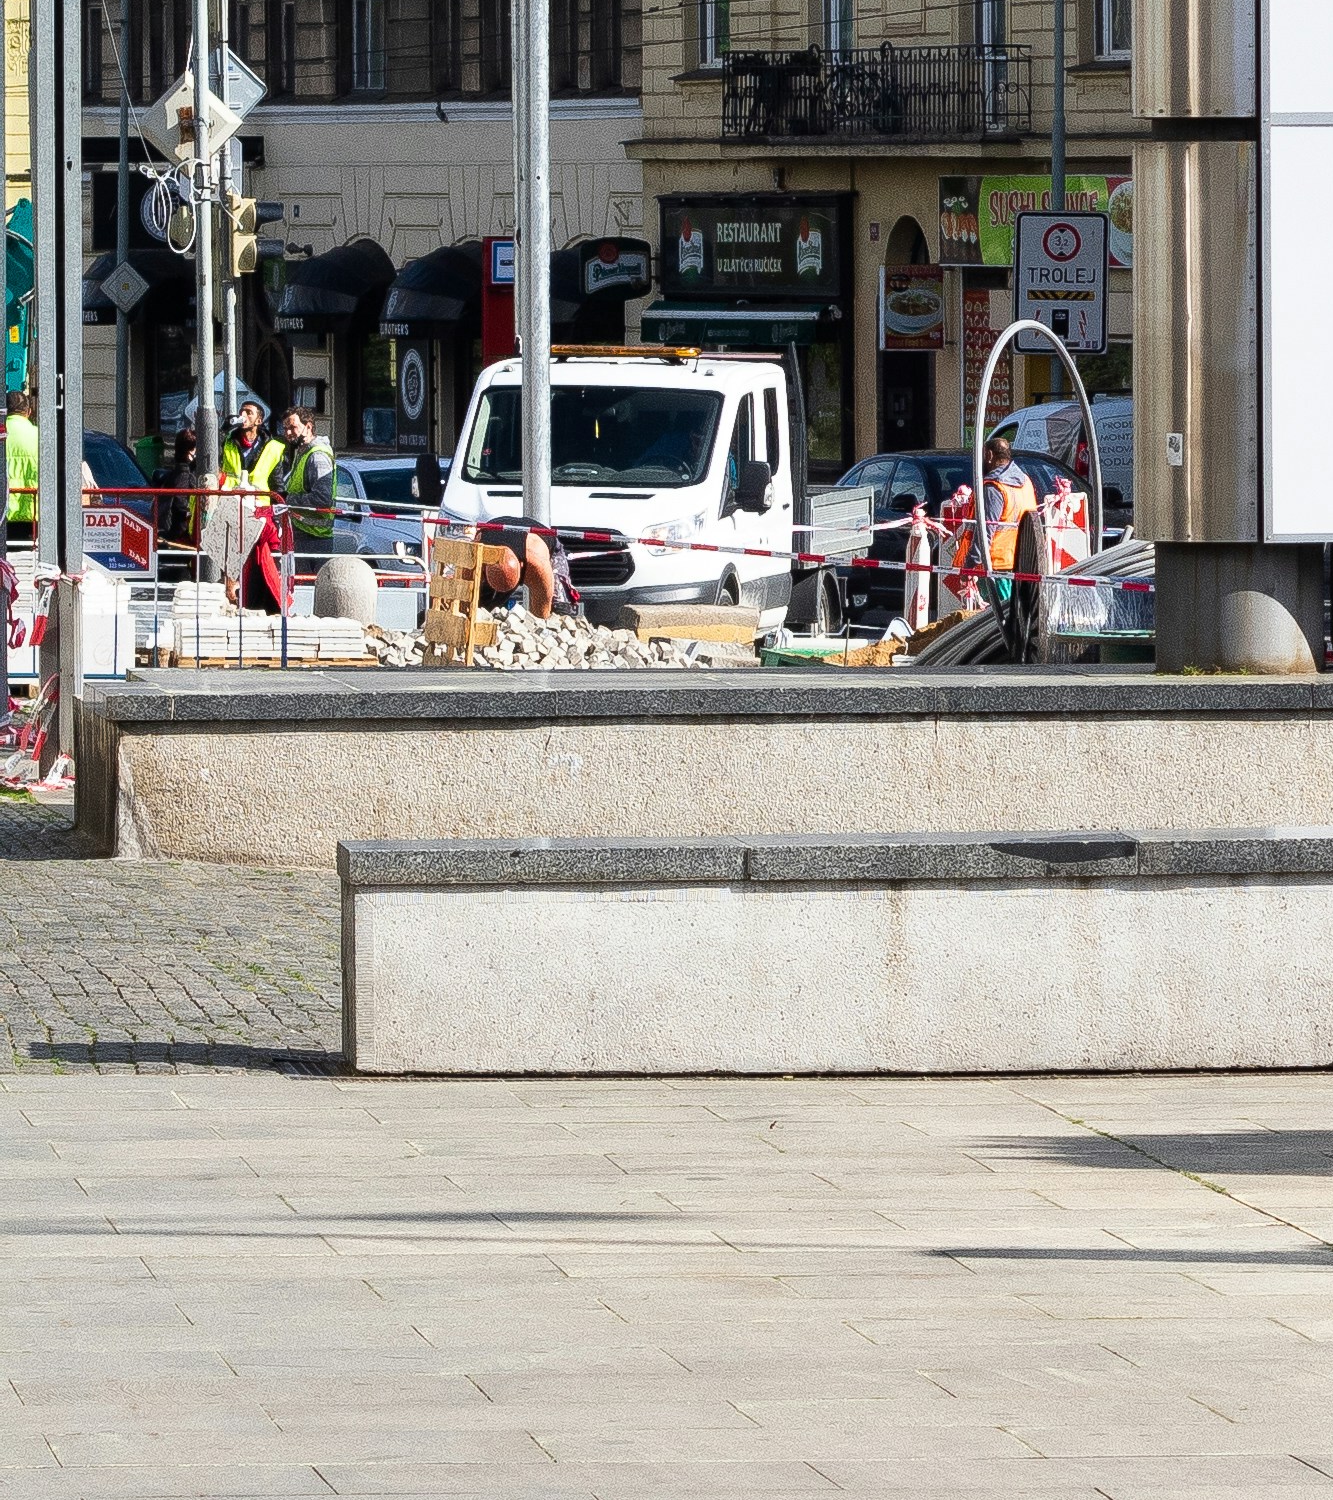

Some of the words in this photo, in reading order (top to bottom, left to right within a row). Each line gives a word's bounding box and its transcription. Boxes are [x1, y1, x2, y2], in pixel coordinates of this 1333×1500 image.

[716, 222, 782, 243] RESTAURANT
[717, 259, 723, 273] U
[723, 256, 753, 273] ZLATÝCH
[754, 256, 782, 273] RUČIČEK
[1027, 267, 1097, 284] TROLEJ
[86, 515, 119, 527] DAP
